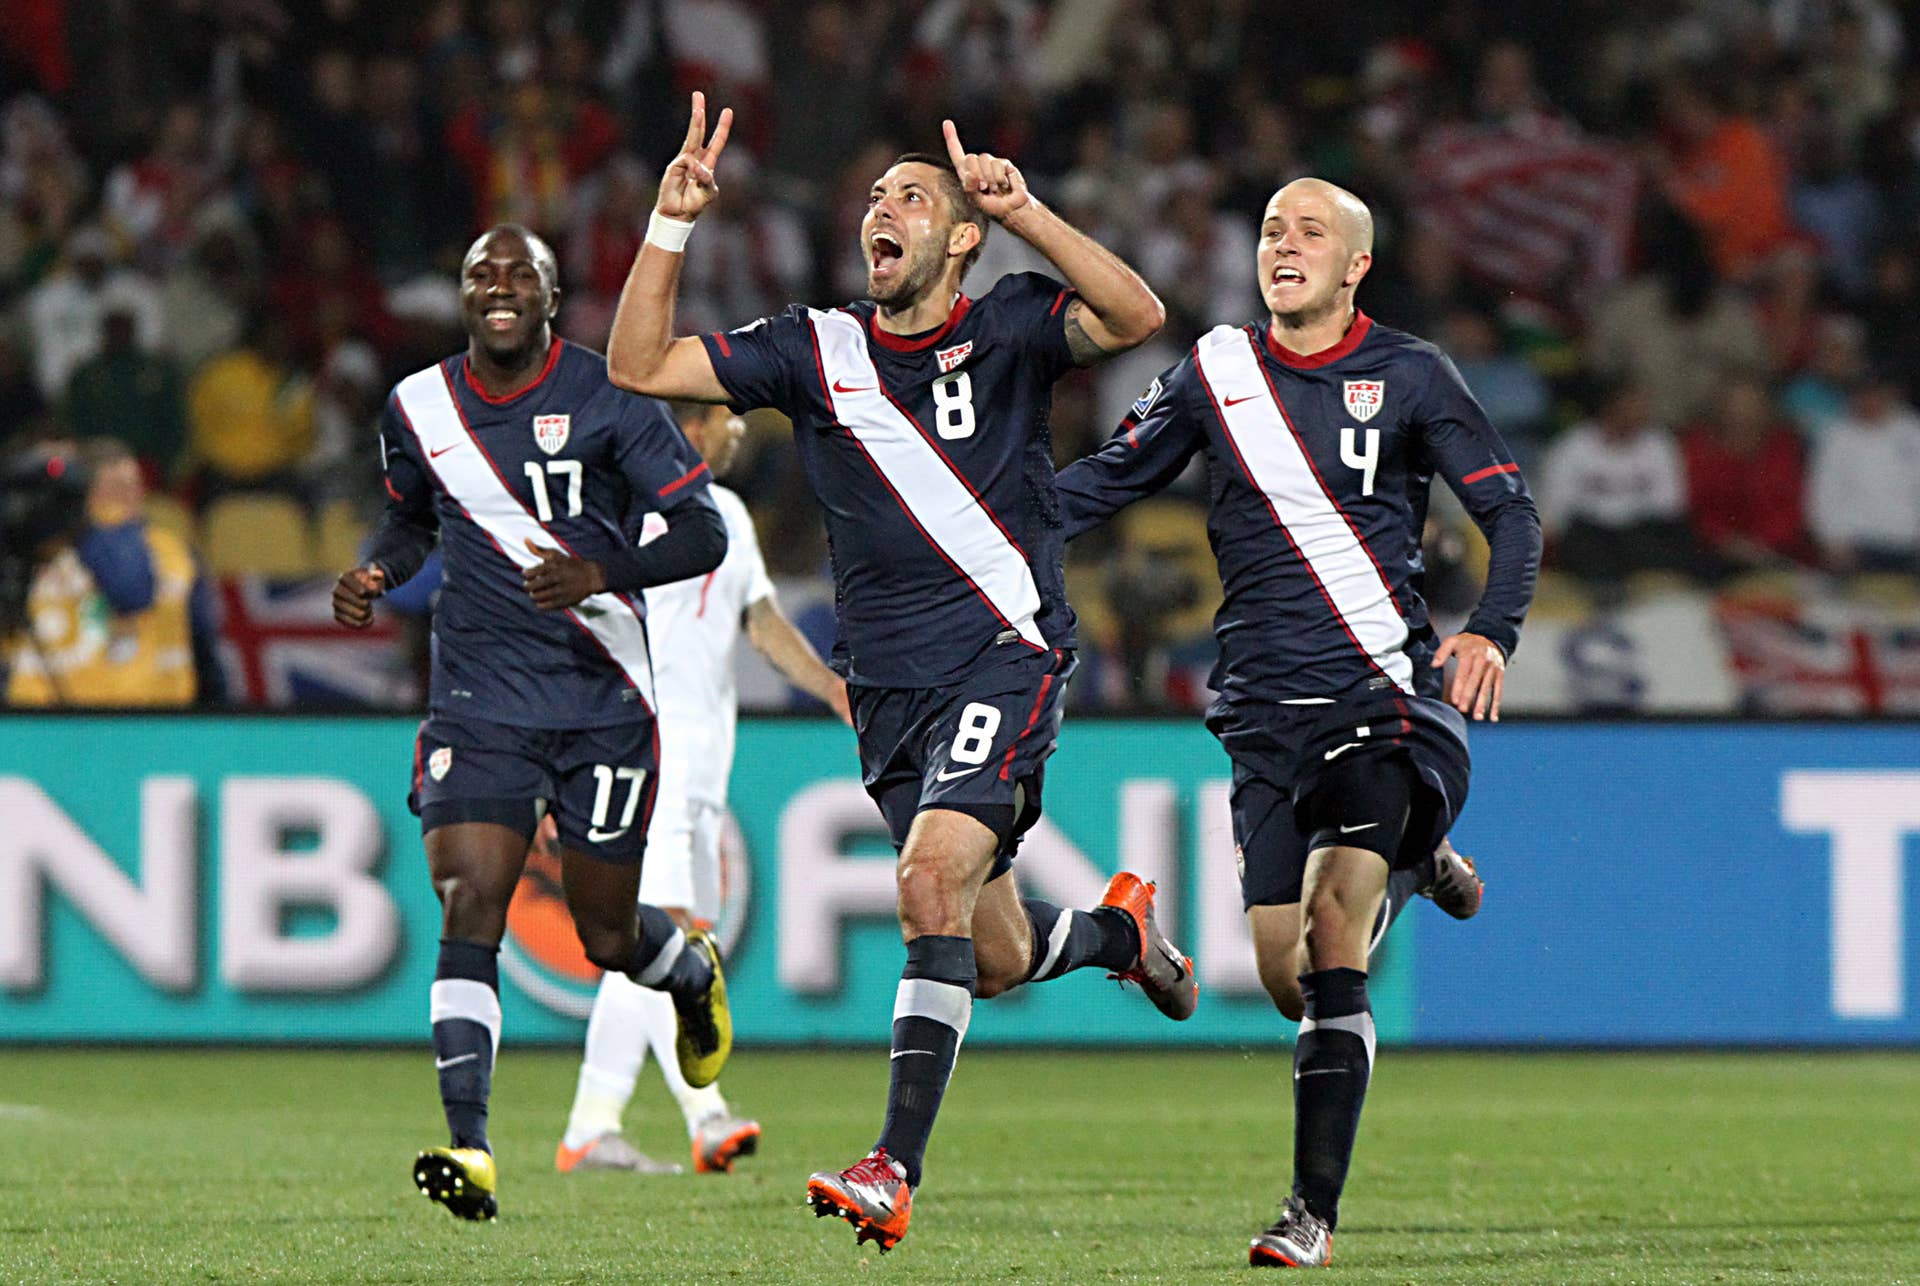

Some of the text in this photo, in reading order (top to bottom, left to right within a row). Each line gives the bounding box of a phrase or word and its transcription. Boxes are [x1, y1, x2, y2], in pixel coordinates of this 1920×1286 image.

[932, 371, 976, 440] 8
[524, 460, 583, 522] 17
[1340, 427, 1380, 497] 4
[950, 702, 1002, 765] 8
[591, 764, 647, 827] 17
[0, 775, 399, 992] NB
[1779, 769, 1920, 1019] T
